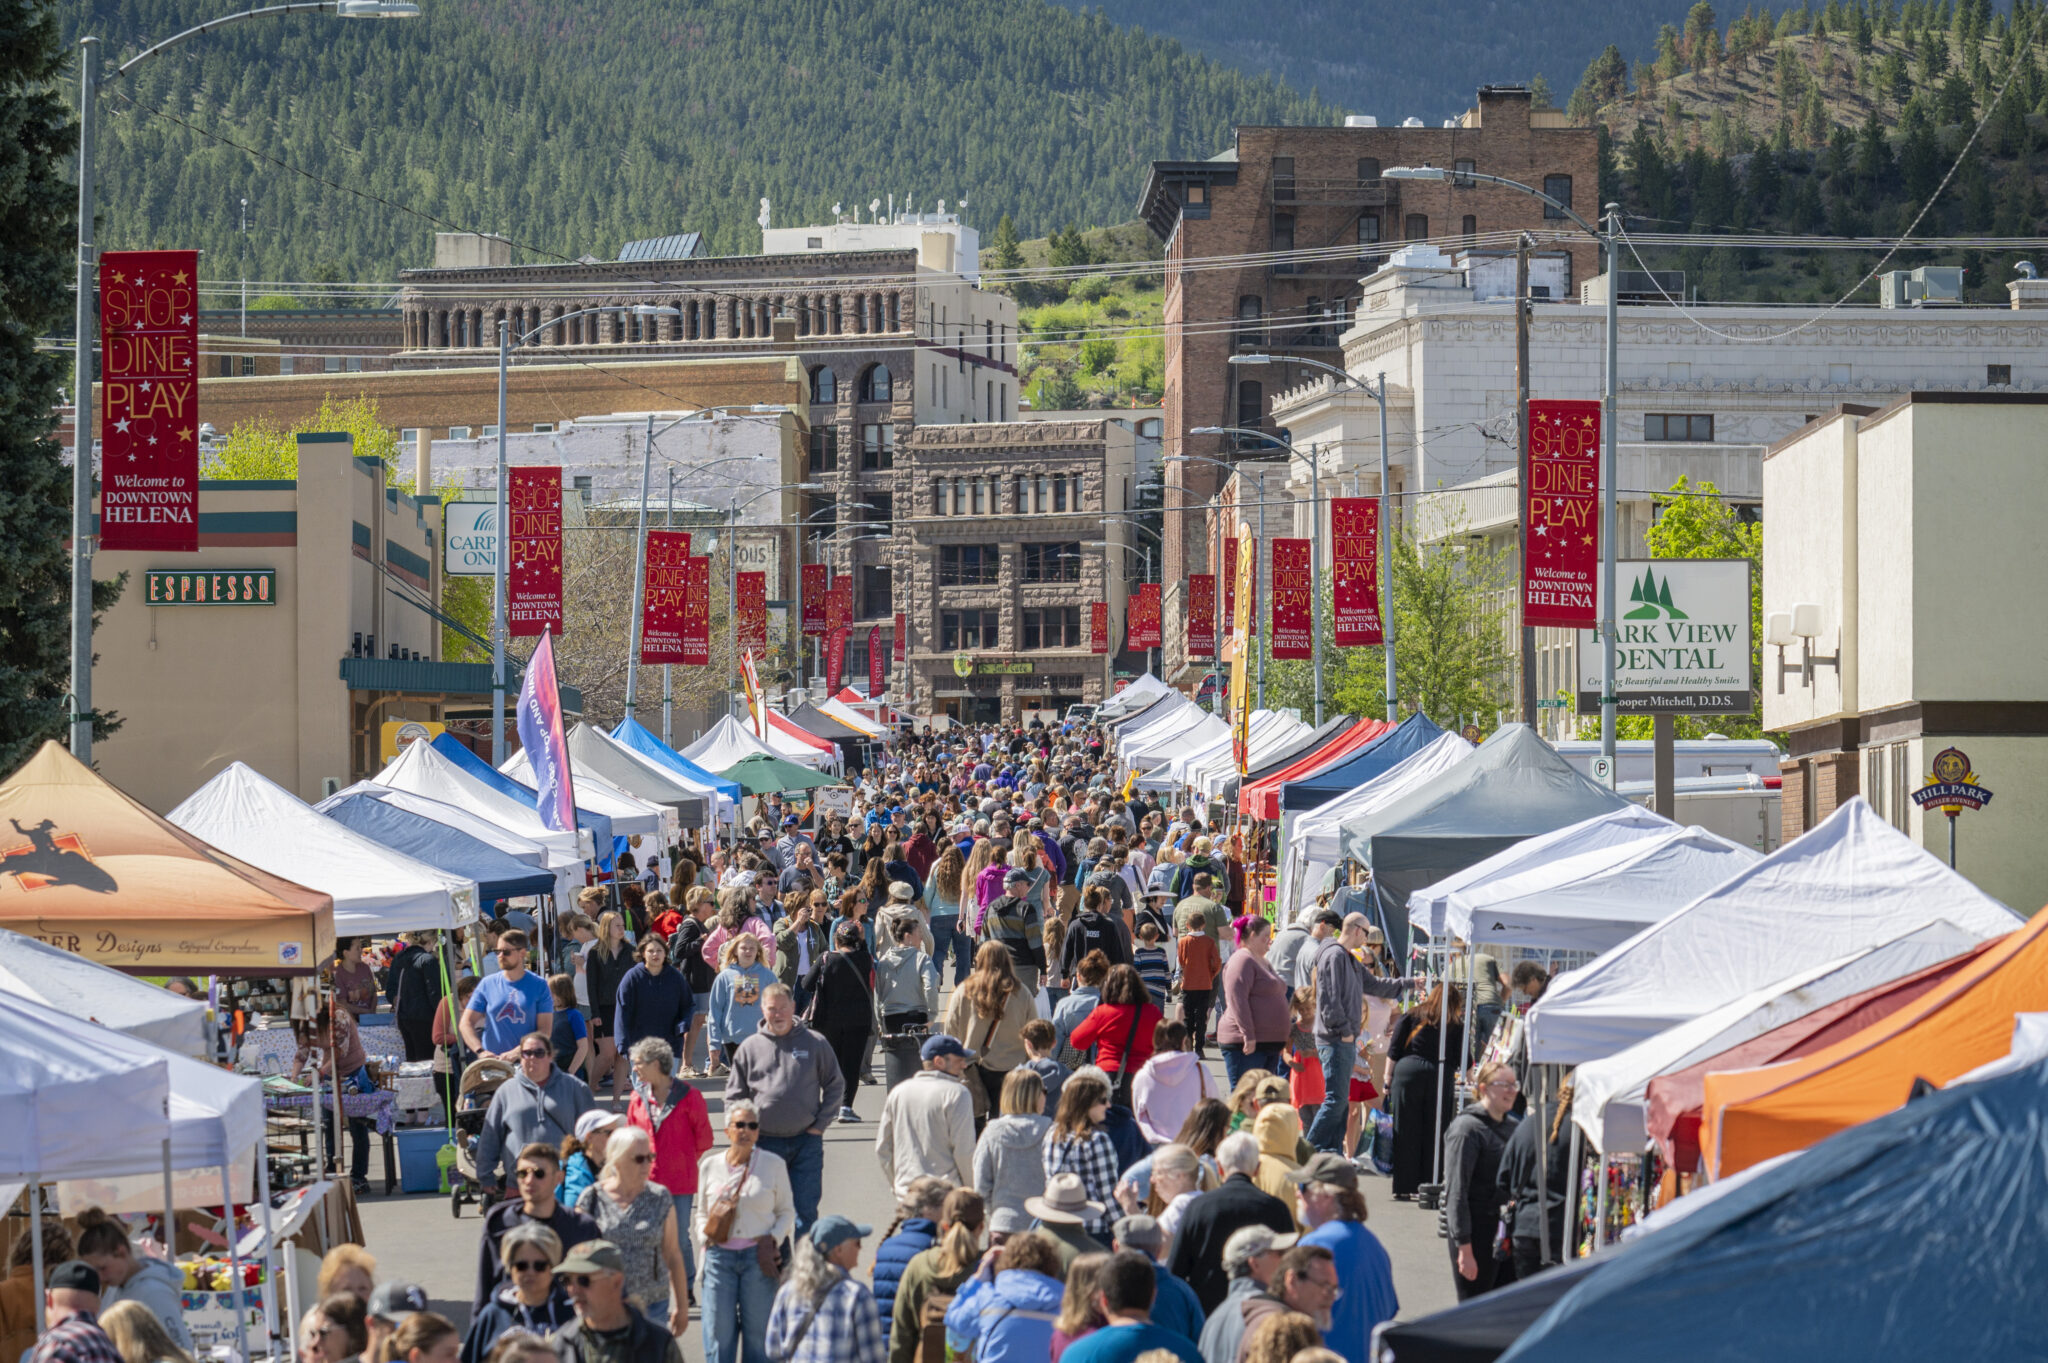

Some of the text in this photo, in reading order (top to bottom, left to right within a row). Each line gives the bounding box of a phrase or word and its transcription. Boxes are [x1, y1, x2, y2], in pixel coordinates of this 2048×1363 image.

[106, 289, 191, 327] SHOP
[109, 336, 190, 373] DINE
[107, 382, 192, 419] PLAY
[1532, 427, 1596, 457] SHOP
[114, 474, 186, 488] Welcome to
[1532, 463, 1593, 493] DINE
[106, 491, 193, 504] DOWNTOWN
[512, 487, 560, 510] SHOP
[104, 506, 194, 524] HELENA
[1530, 498, 1594, 528] PLAY
[512, 514, 558, 536] DINE
[1334, 515, 1376, 535] SHOP
[449, 535, 509, 551] CARP
[511, 540, 560, 562] PLAY
[1335, 538, 1374, 558] DINE
[648, 547, 688, 567] SHOP
[1274, 552, 1309, 569] SHOP
[647, 568, 685, 587] DINE
[1335, 561, 1375, 581] PLAY
[1534, 566, 1588, 580] Welcome to
[1274, 571, 1308, 588] DINE
[1528, 580, 1593, 592] DOWNTOWN
[150, 575, 269, 602] ESPRESSO
[515, 592, 556, 600] Welcome to
[687, 586, 708, 601] INE
[512, 601, 560, 610] DOWNTOWN
[646, 588, 684, 607] PLAY
[1273, 590, 1309, 606] PLAY
[1527, 592, 1594, 608] HELENA
[511, 610, 561, 621] HELENA
[685, 603, 708, 618] LAY
[1189, 609, 1213, 620] PLAY
[1340, 607, 1367, 615] Welcome
[1337, 615, 1379, 623] DOWNTOWN
[647, 629, 674, 637] Welcome
[1336, 622, 1381, 633] HELENA
[643, 637, 682, 645] DOWNTOWN
[643, 644, 682, 653] HELENA
[1273, 640, 1310, 649] HELENA
[1624, 676, 1663, 688] Beautiful
[1663, 676, 1679, 685] and
[1680, 676, 1713, 688] Healthy
[1714, 676, 1740, 685] Smiles
[1650, 695, 1697, 708] Mitchell,
[1698, 695, 1734, 706] D.D.S.
[529, 698, 545, 726] AND
[1598, 762, 1607, 774] P
[1917, 785, 1987, 803] HILL PARK
[1927, 797, 1977, 807] FULLER AVENUE
[96, 929, 163, 961] Designs
